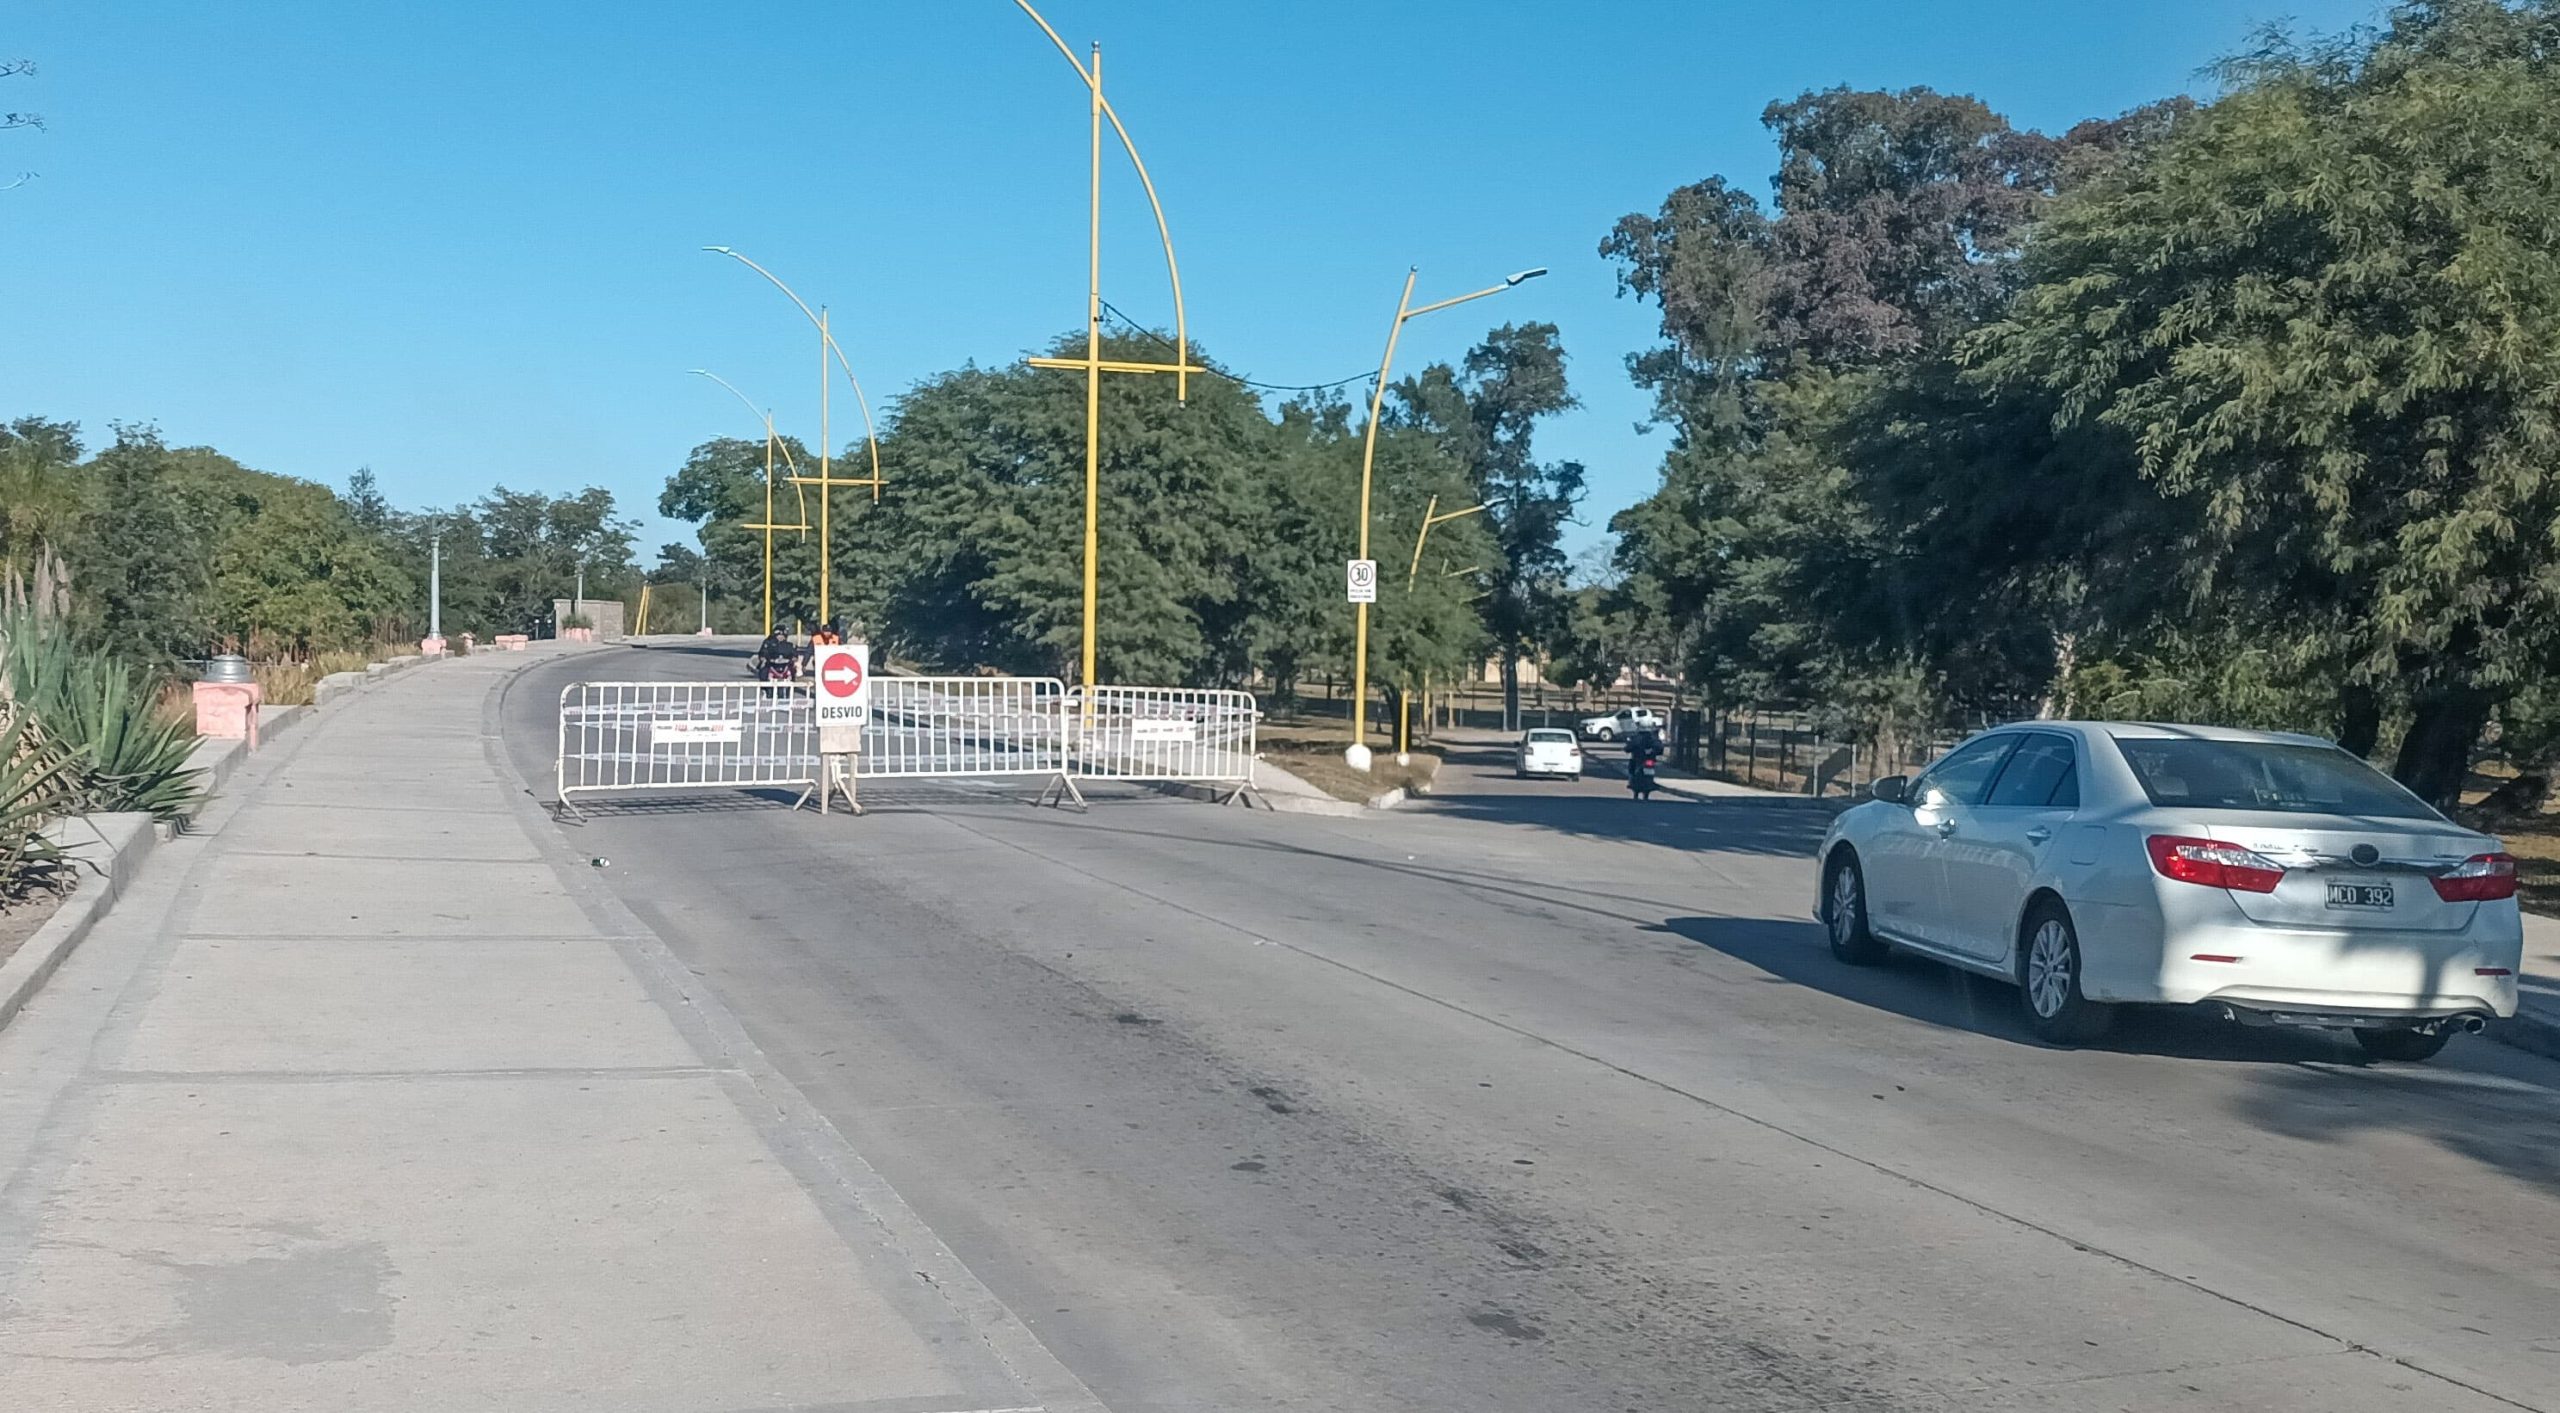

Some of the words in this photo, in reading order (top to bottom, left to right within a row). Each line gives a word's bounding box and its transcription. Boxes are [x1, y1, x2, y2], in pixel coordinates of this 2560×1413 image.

[1355, 567, 1368, 582] 30
[822, 706, 862, 719] DESVIO
[2364, 887, 2392, 906] 392
